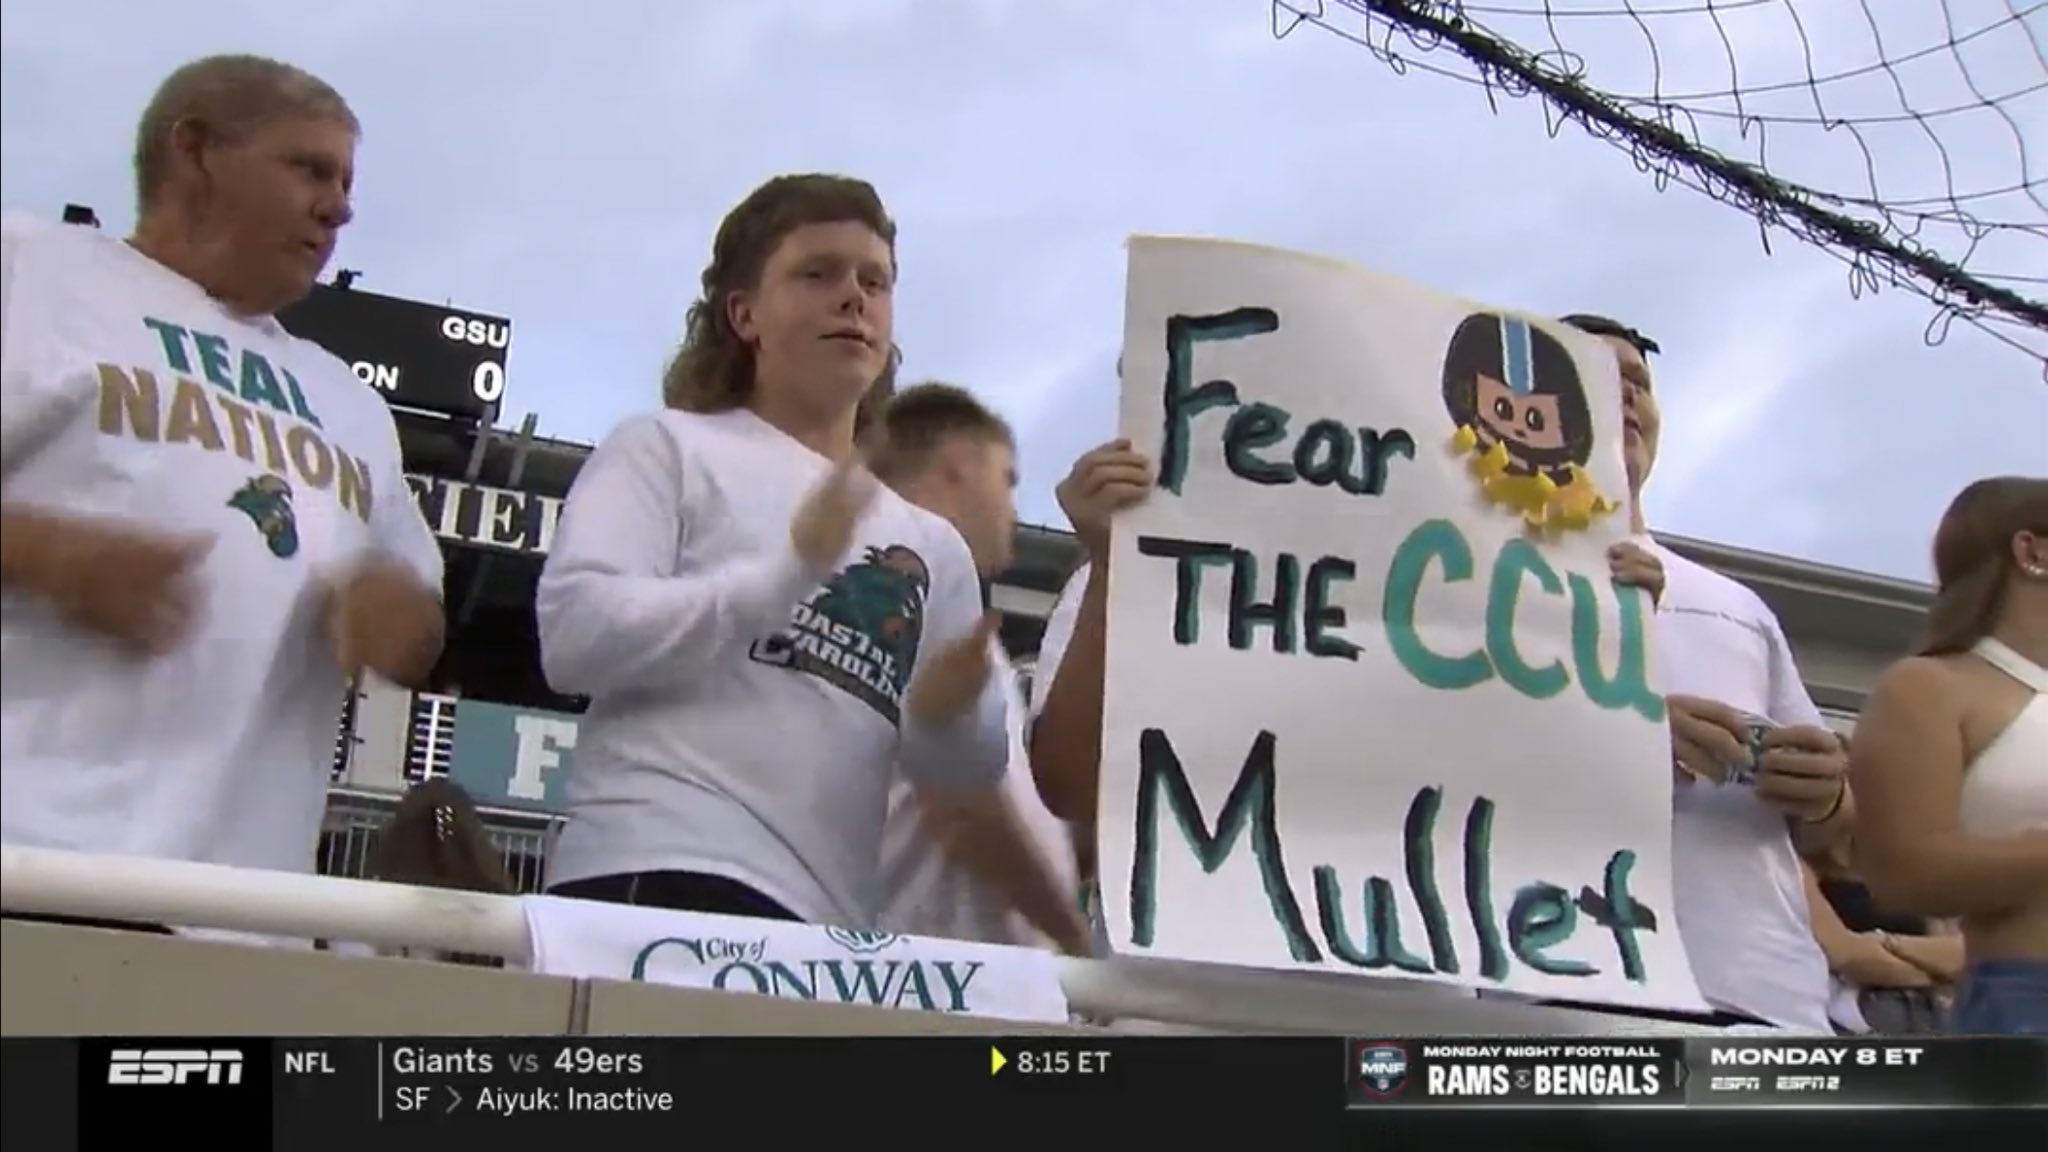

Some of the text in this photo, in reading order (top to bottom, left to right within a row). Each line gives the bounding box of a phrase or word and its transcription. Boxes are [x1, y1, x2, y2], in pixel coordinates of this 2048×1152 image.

[143, 316, 324, 429] TEAL
[351, 361, 399, 390] ON
[442, 316, 508, 348] GSU
[473, 360, 505, 402] 0
[1159, 306, 1416, 496] Fear
[96, 362, 373, 524] NATION
[790, 602, 897, 676] OASTAL
[1137, 517, 1666, 724] THE CCU
[1130, 728, 1659, 984] Mullet
[705, 937, 769, 962] City of
